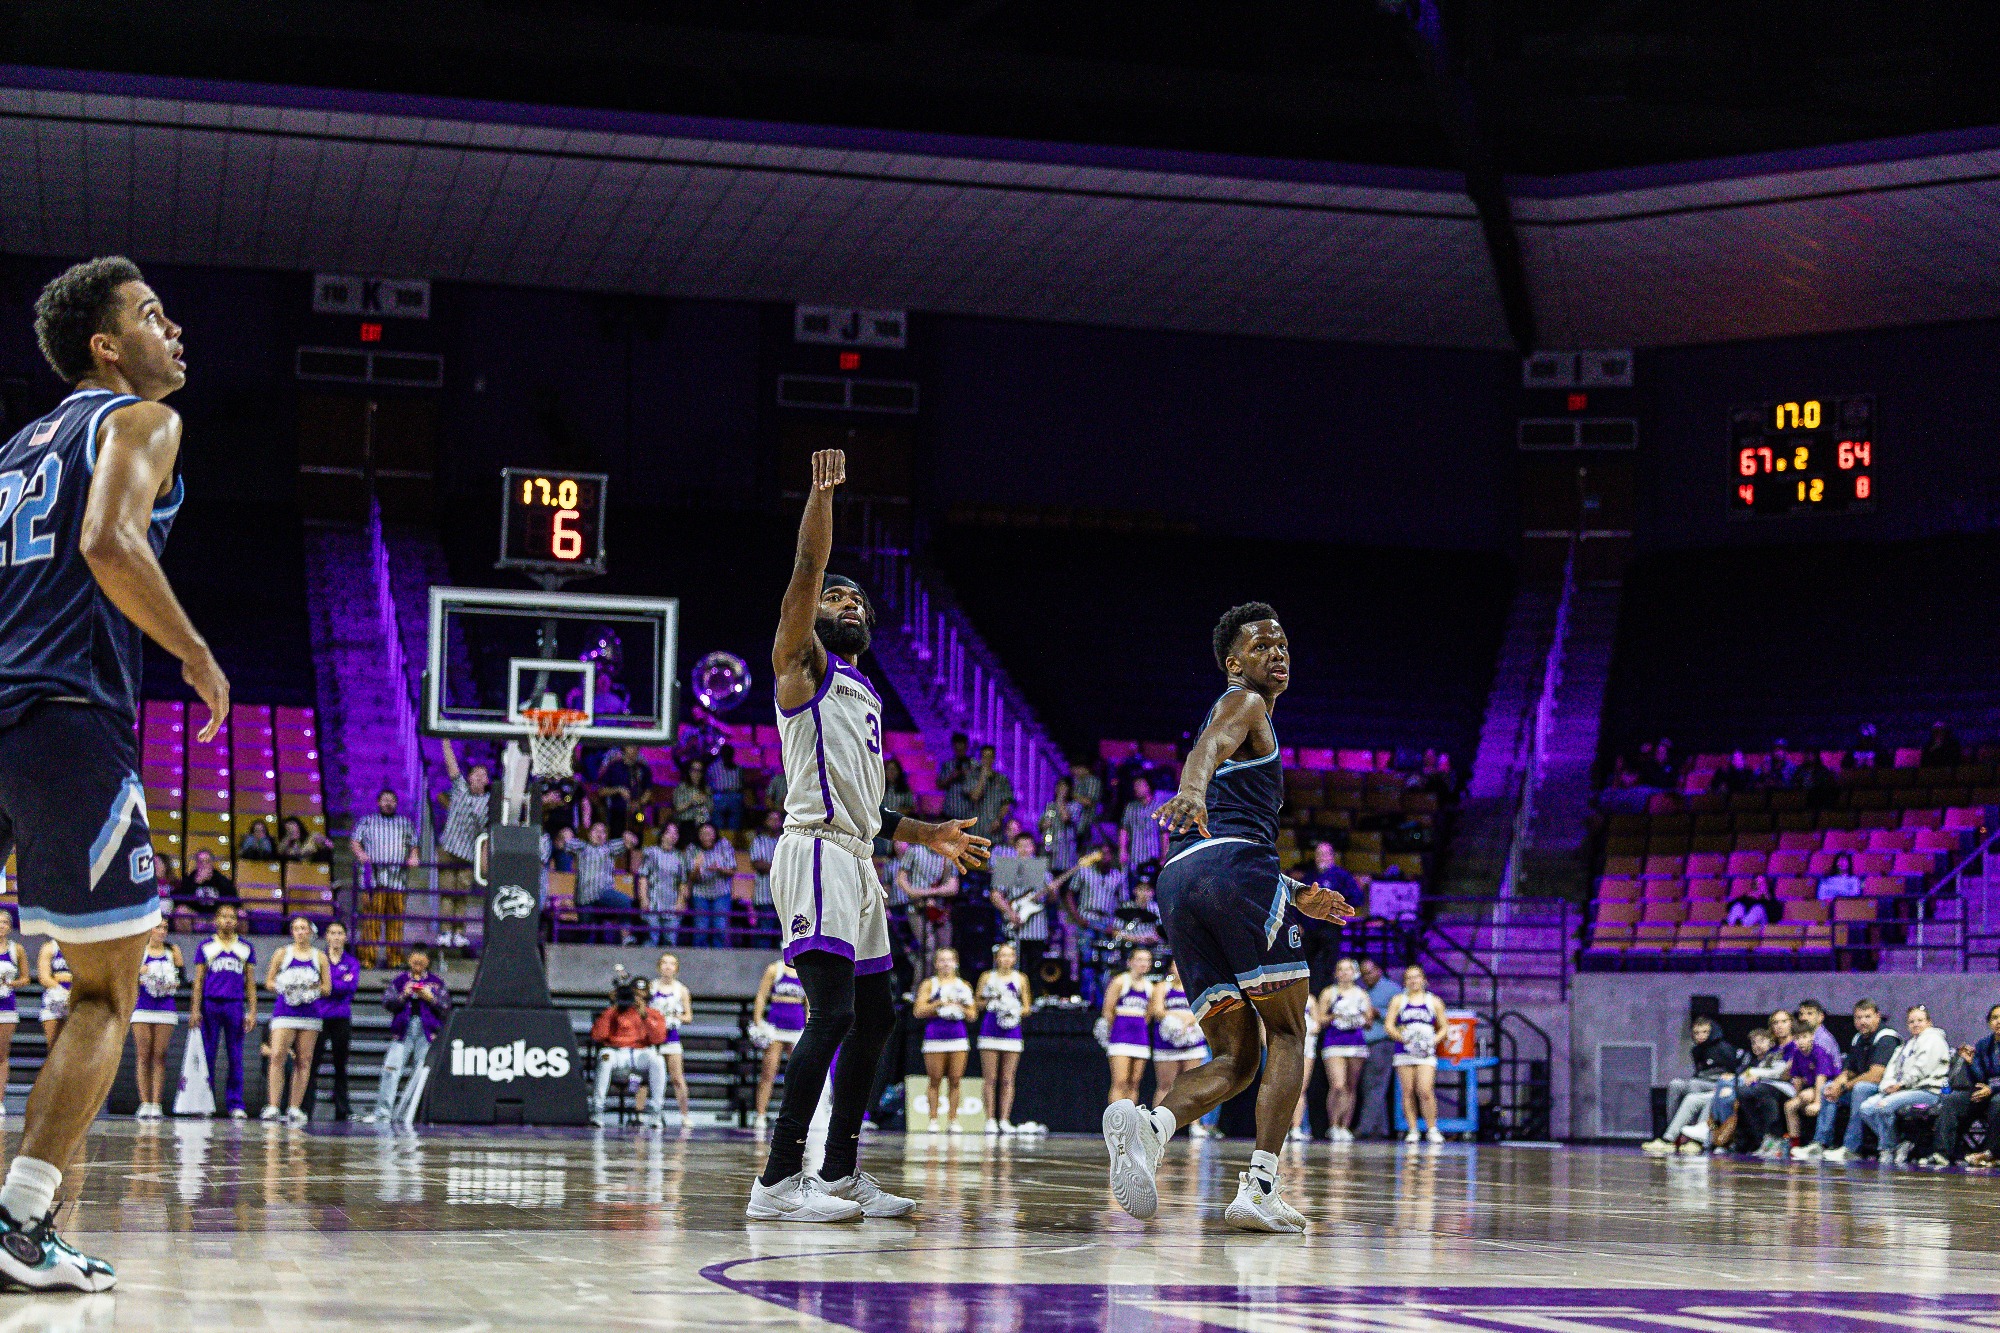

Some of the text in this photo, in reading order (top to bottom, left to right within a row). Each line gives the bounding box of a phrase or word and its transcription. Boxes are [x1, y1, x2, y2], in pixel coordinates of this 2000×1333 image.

[361, 281, 382, 311] K
[841, 312, 860, 340] J
[1776, 401, 1821, 429] 17.0
[1740, 447, 1772, 476] 67
[1794, 447, 1809, 470] 2
[1838, 441, 1871, 470] 64
[523, 478, 578, 509] 17.0
[1739, 484, 1754, 505] 4
[1798, 479, 1824, 502] 12
[1856, 475, 1871, 499] 8
[552, 509, 582, 559] 6
[865, 711, 881, 755] 3
[451, 1038, 571, 1083] ingles
